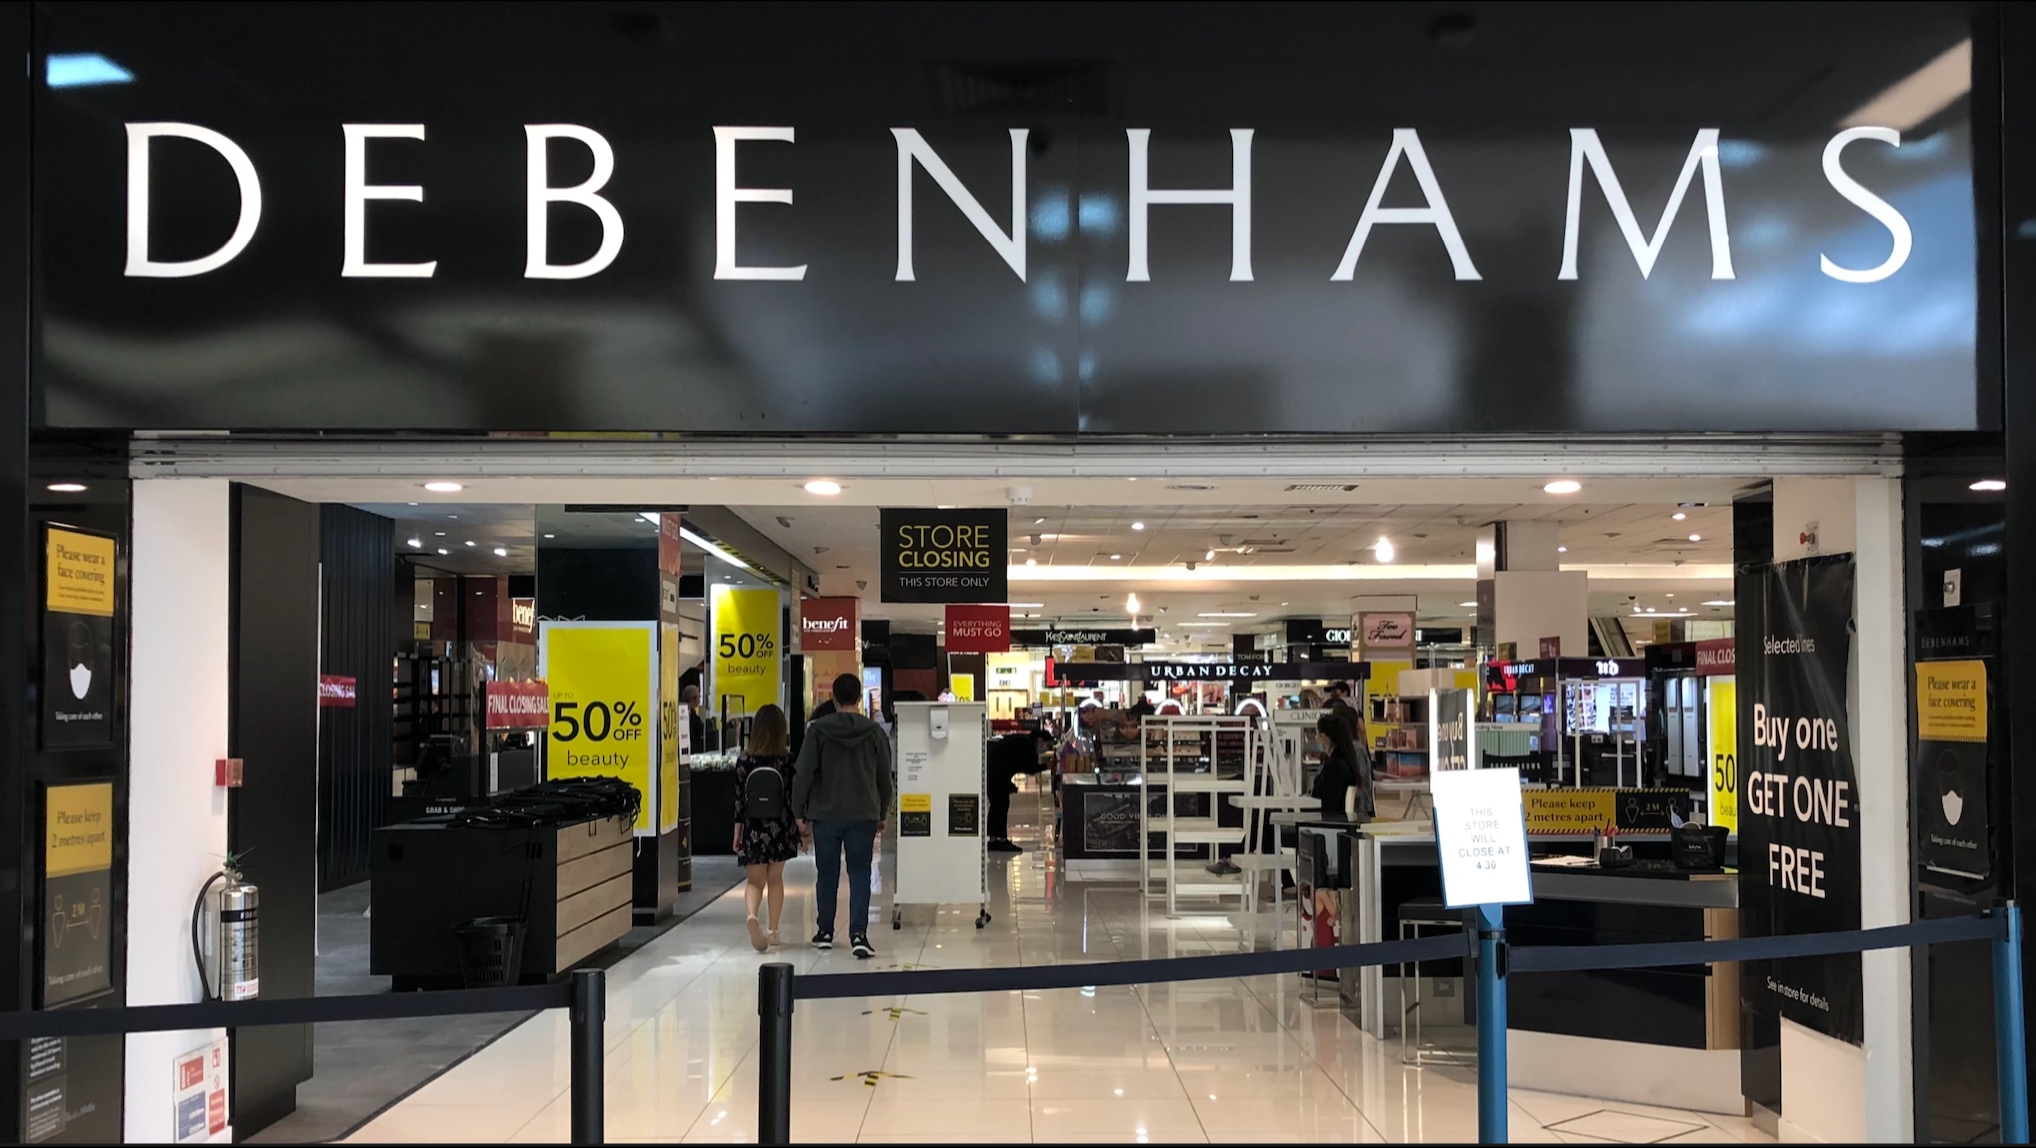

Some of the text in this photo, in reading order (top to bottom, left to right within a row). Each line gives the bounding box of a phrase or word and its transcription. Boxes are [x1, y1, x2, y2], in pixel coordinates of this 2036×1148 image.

[124, 122, 1913, 283] DEBENHAMS
[898, 524, 990, 549] STORE
[56, 543, 106, 566] Please wear a
[898, 550, 990, 568] CLOSING
[57, 562, 105, 587] face covering
[899, 577, 990, 588] THIS STORE ONLY
[513, 598, 536, 633] benef
[802, 616, 849, 633] benefit
[952, 628, 1002, 638] MUST GO
[953, 620, 1002, 629] EVERYTHING
[719, 633, 774, 659] 50%
[1763, 634, 1800, 655] Selected
[756, 650, 774, 659] OFF
[1697, 648, 1735, 666] FINAL CLOS
[727, 662, 766, 677] beauty
[1150, 665, 1272, 679] URBAN DECAY
[1927, 676, 1976, 691] Please wear a
[488, 693, 508, 714] FINAL
[509, 694, 537, 715] CLOSING
[1927, 692, 1976, 712] face covering
[552, 700, 642, 743] 50%
[1290, 710, 1325, 721] CLINIQ
[613, 728, 642, 741] OFF
[1753, 703, 1839, 762] Buy one
[567, 749, 629, 770] beauty
[1715, 753, 1736, 793] 50
[1531, 797, 1596, 811] Please keep
[1747, 770, 1850, 828] GET ONE
[57, 809, 101, 826] Please keep
[1100, 812, 1127, 820] GOOD
[1470, 807, 1493, 817] THIS
[1720, 801, 1737, 818] beau
[1464, 820, 1500, 831] STORE
[1524, 812, 1604, 825] 2 metres apart
[58, 835, 85, 847] metres
[86, 831, 105, 847] apart
[1471, 834, 1496, 843] WILL
[1458, 845, 1511, 858] CLOSE AT
[1476, 860, 1497, 870] 4.30
[1768, 842, 1826, 899] FREE
[1766, 975, 1778, 992] See
[1800, 987, 1810, 1004] for
[1809, 992, 1830, 1013] details
